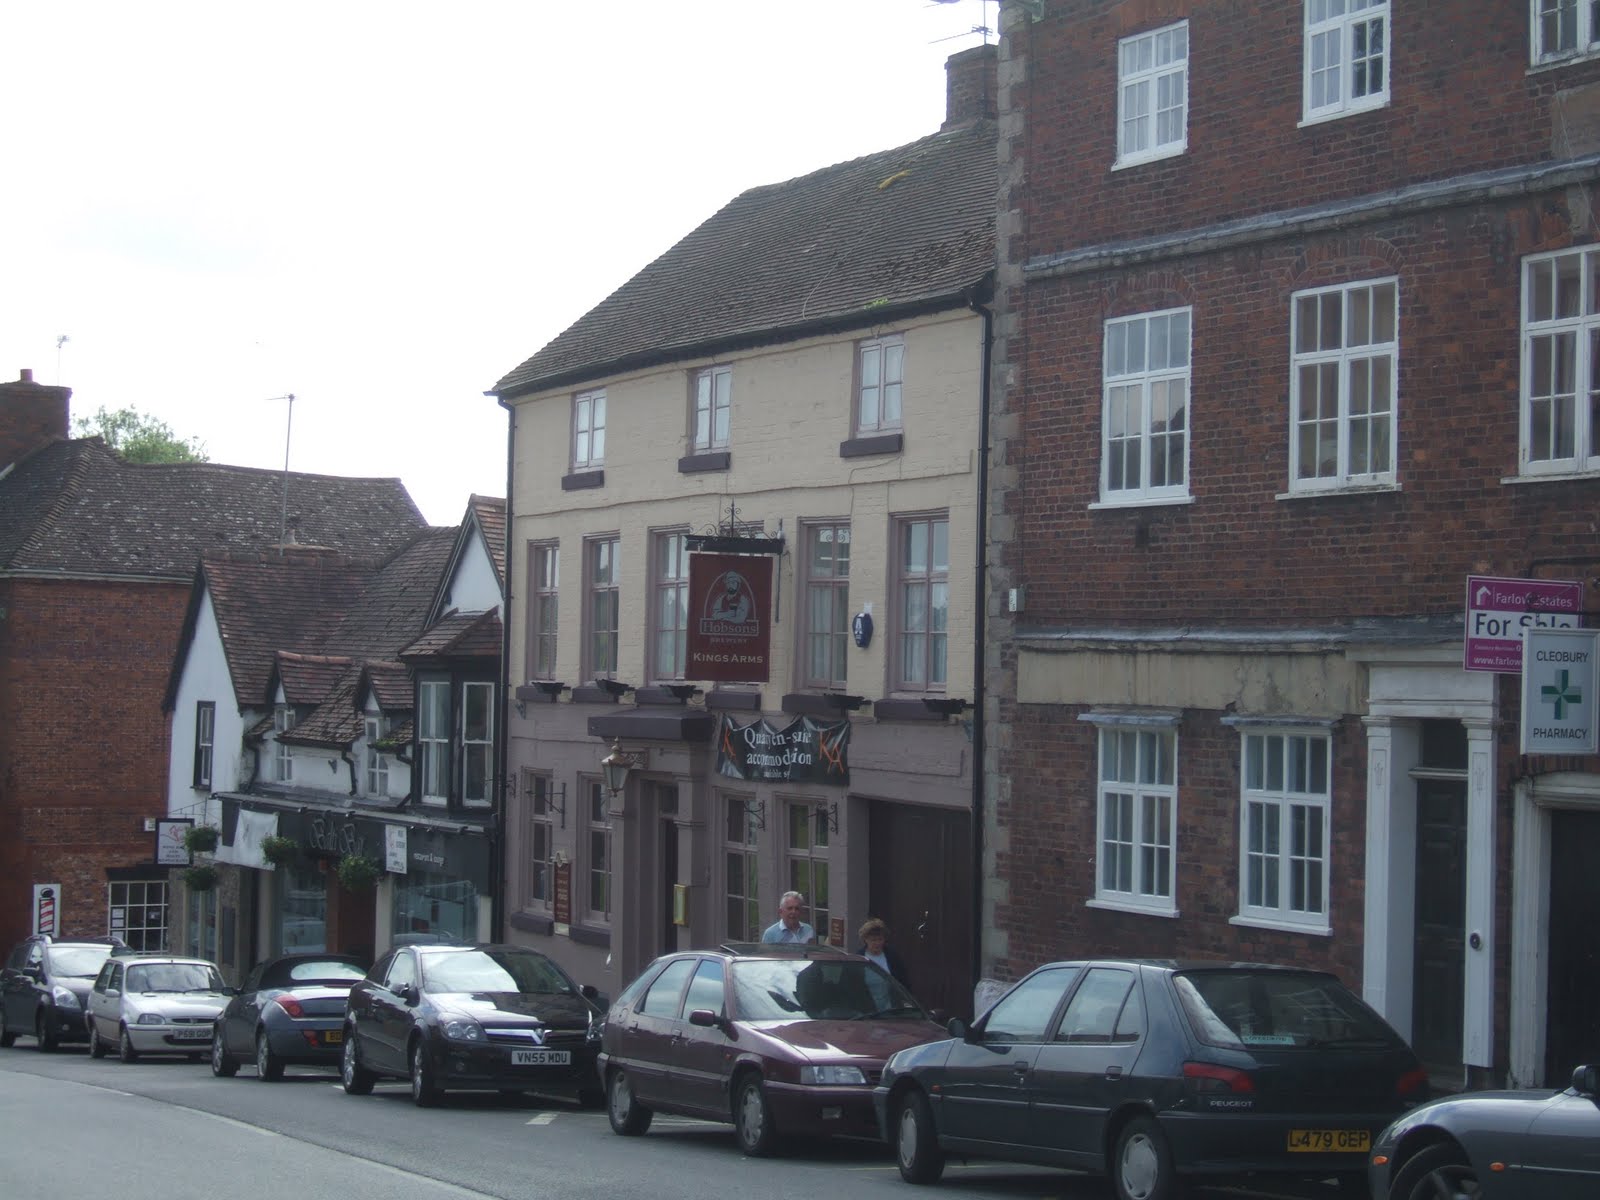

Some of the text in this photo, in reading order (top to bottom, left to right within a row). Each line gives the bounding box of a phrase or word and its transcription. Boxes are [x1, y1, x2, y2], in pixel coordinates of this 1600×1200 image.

[1534, 595, 1573, 607] states
[703, 622, 757, 634] Hobsons
[1475, 613, 1512, 637] For
[693, 652, 764, 664] KINGS ARMS
[1474, 656, 1523, 667] www.farlow
[1536, 650, 1589, 662] CLEOBURY
[1533, 727, 1588, 739] PHARMACY
[517, 1052, 568, 1063] VN55 MDU
[1289, 1131, 1333, 1148] L479
